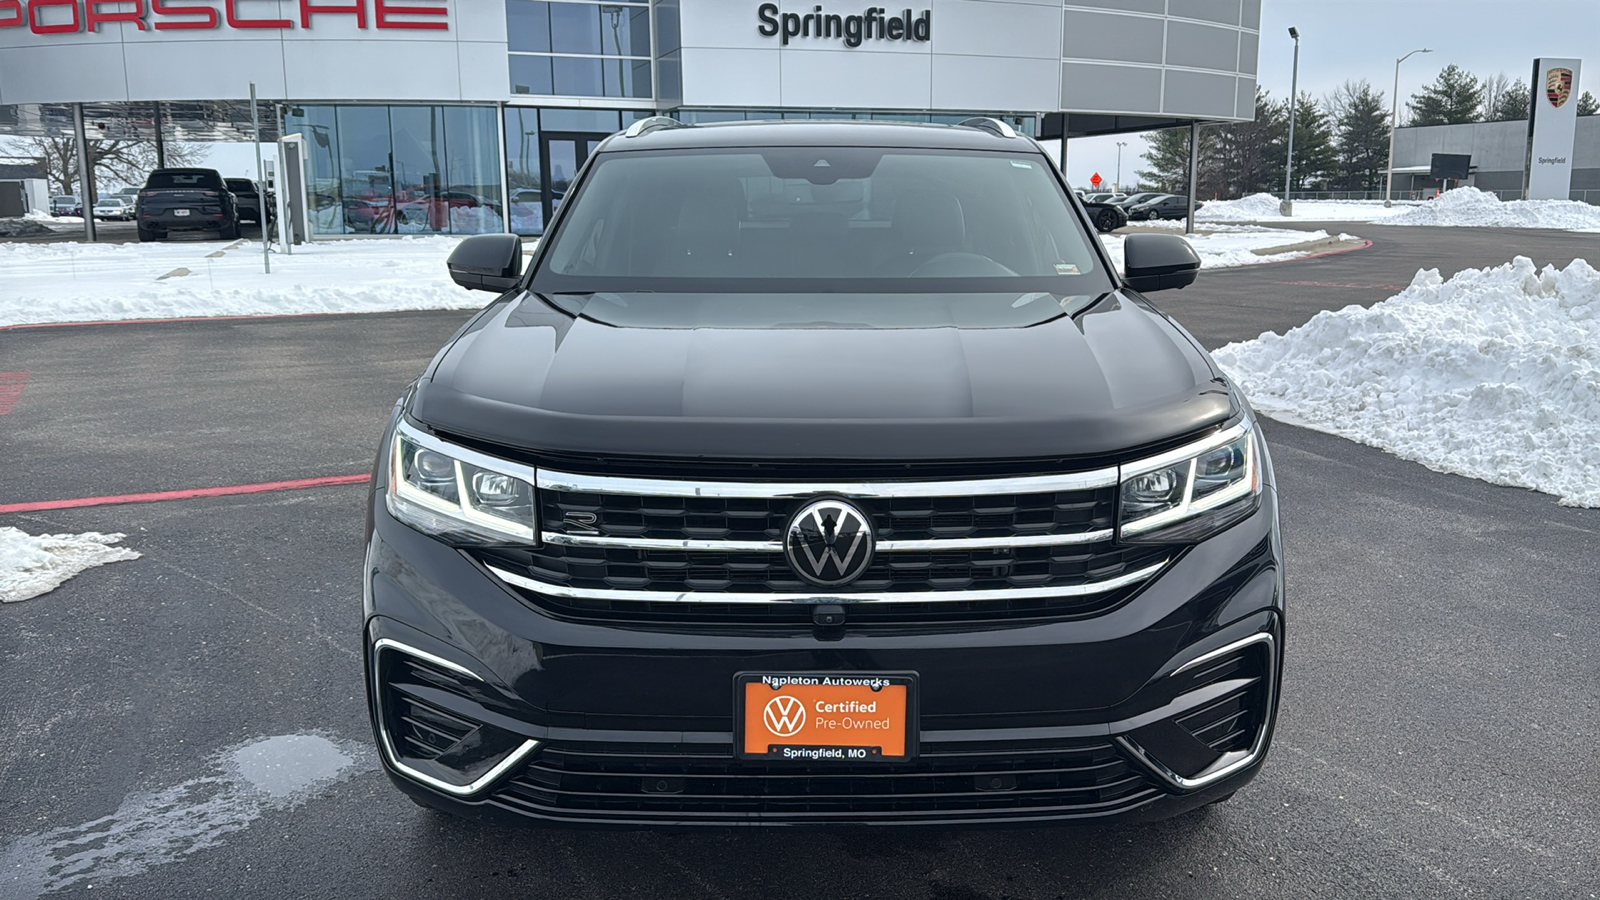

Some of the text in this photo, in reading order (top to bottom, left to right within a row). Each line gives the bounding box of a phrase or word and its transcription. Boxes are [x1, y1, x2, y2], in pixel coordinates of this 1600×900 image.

[757, 3, 931, 48] Springfield
[1538, 156, 1566, 165] Springfield
[762, 675, 890, 687] Napleton Autowerks
[815, 700, 877, 713] Certified
[815, 717, 890, 730] Pre-Owned
[783, 747, 867, 760] Springfield, MO
